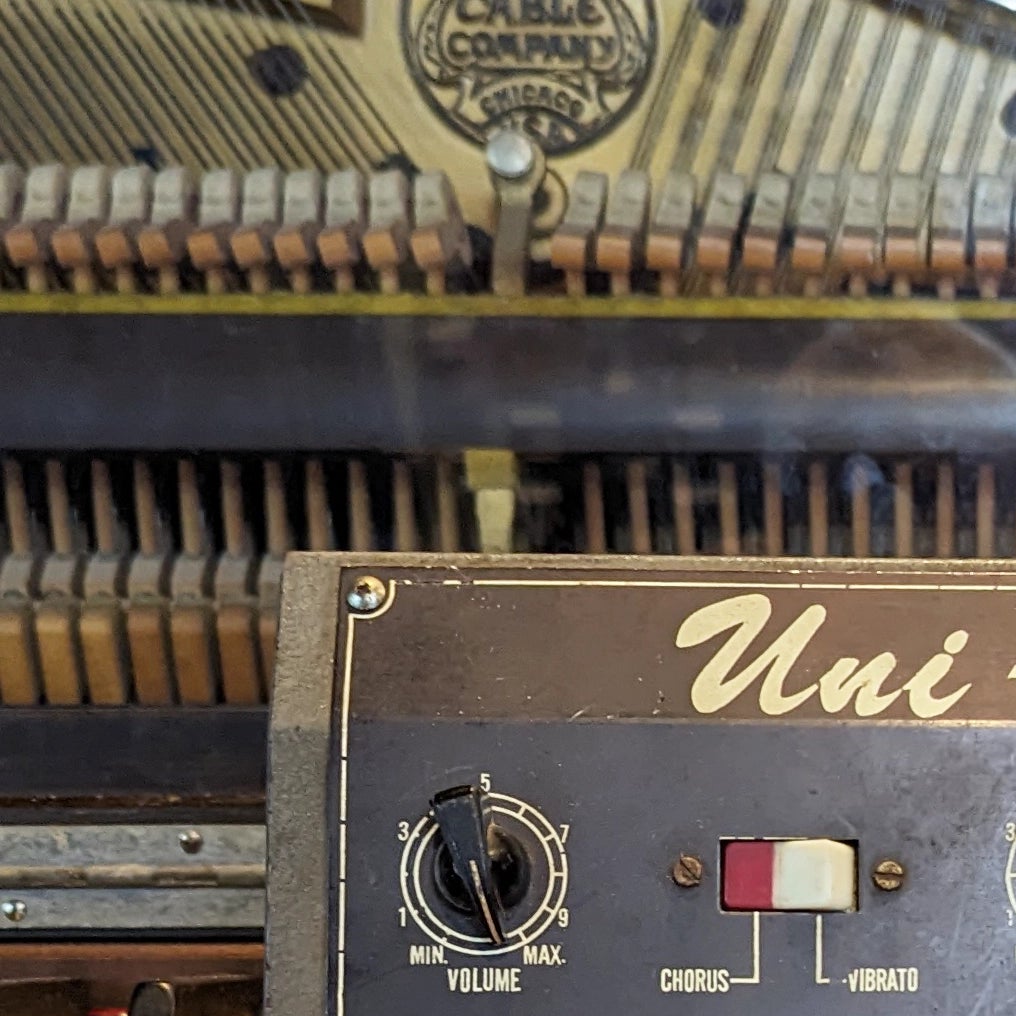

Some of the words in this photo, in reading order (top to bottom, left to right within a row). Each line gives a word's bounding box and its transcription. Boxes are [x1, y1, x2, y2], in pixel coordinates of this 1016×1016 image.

[447, 31, 616, 66] COMPANY
[480, 84, 585, 121] CHICAGO
[480, 773, 491, 791] 5
[397, 821, 410, 841] 3
[559, 824, 570, 843] 7
[1005, 823, 1016, 842] 3
[398, 907, 407, 927] 1
[557, 908, 569, 927] 9
[409, 945, 448, 965] MIN.
[523, 945, 566, 965] MAX.
[447, 967, 522, 993] VOLUME
[660, 968, 730, 992] CHORUS
[848, 967, 918, 992] VIBRATO
